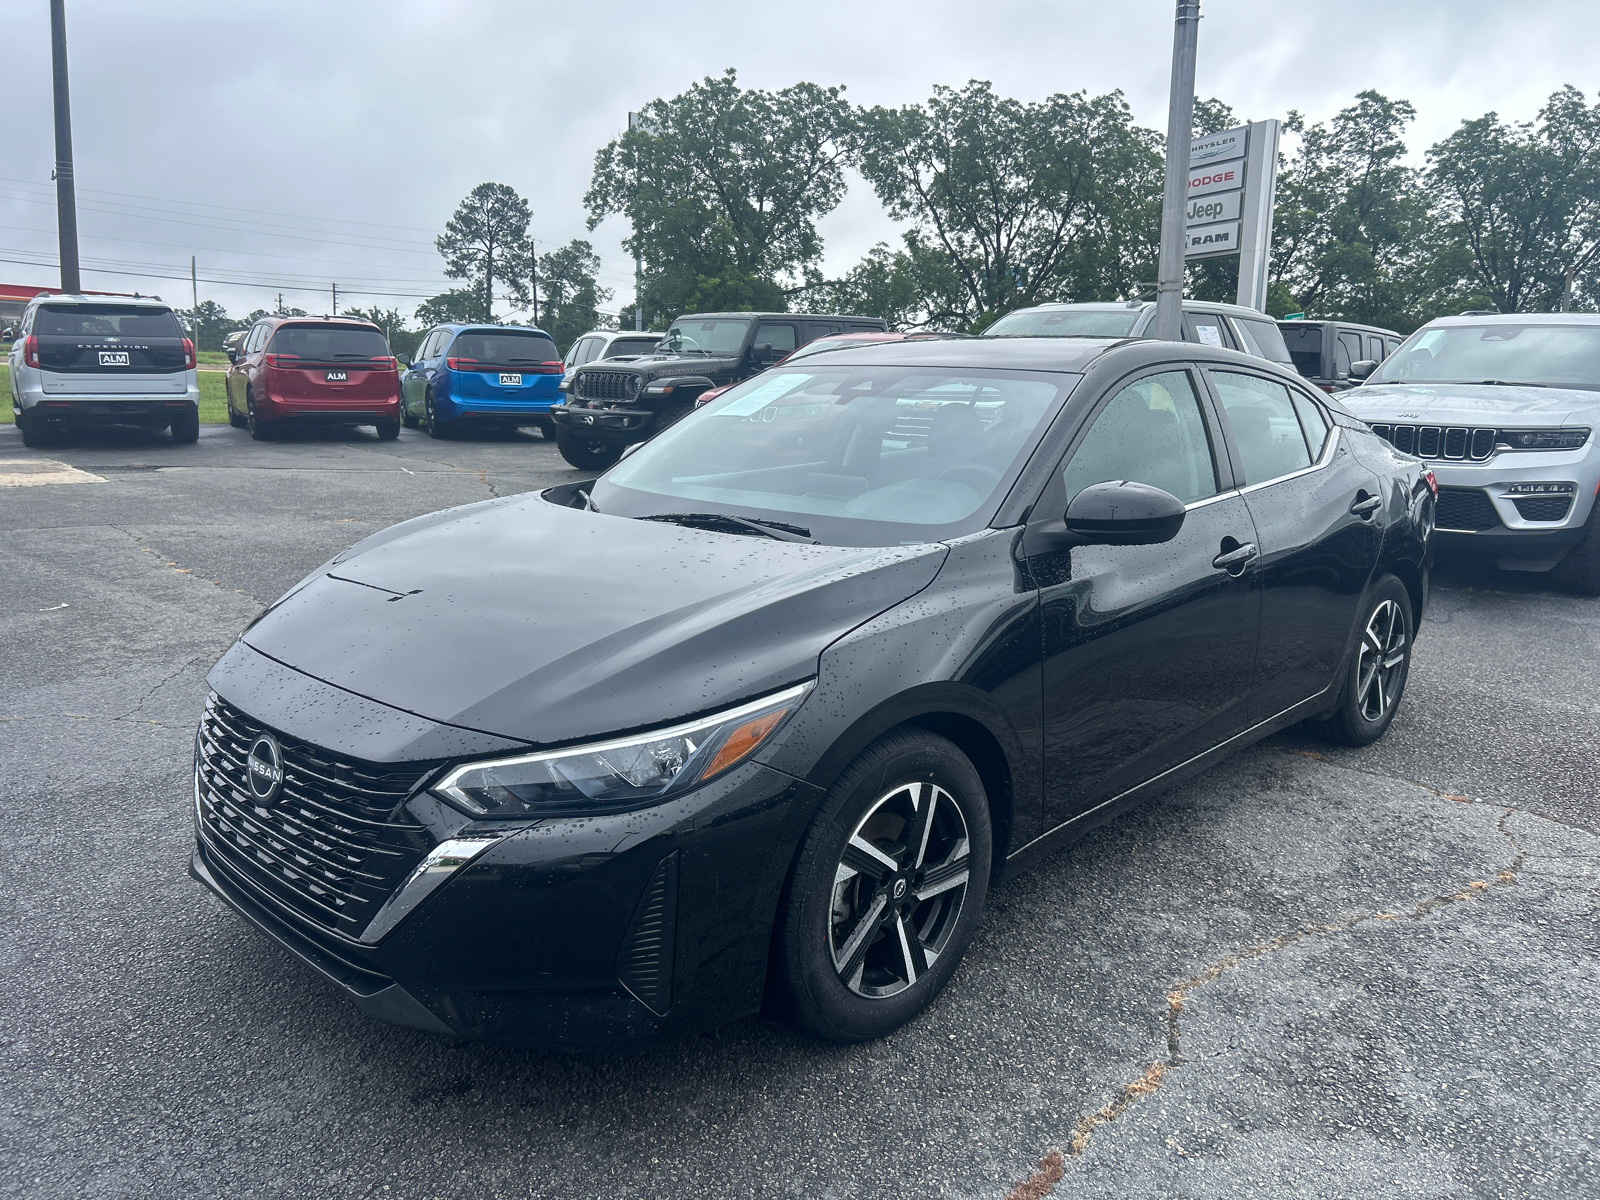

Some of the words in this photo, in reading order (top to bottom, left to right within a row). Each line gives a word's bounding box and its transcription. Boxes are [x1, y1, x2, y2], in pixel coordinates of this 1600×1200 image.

[1191, 137, 1236, 152] HRYSLER
[1187, 202, 1223, 219] Jeep
[1191, 232, 1230, 246] RAM
[102, 355, 126, 363] ALM
[327, 372, 347, 380] ALM
[1397, 410, 1420, 419] Jeep
[248, 755, 281, 781] NISSAN
